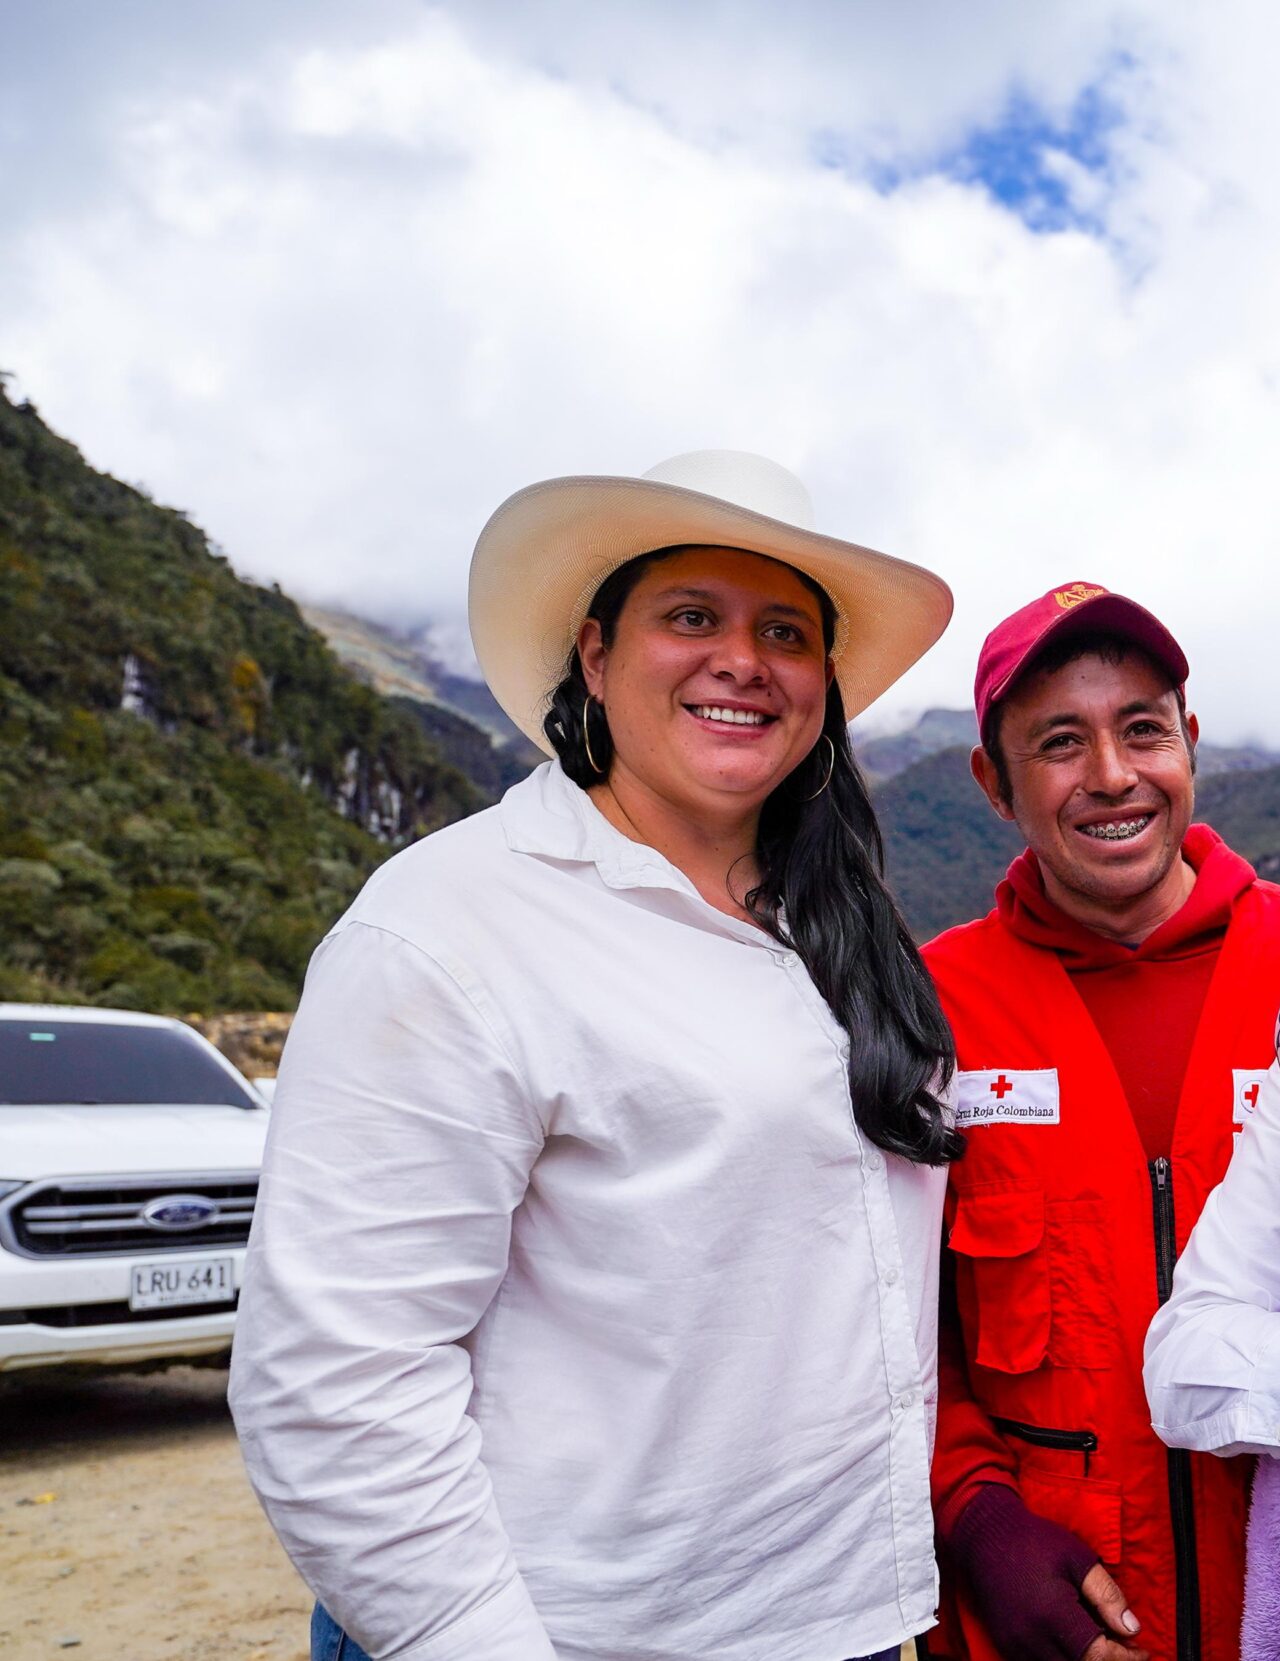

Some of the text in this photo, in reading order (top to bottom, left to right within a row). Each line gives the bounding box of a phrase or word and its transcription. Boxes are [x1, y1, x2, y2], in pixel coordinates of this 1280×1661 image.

[973, 1106, 994, 1118] Roja
[996, 1104, 1054, 1117] Colombiana
[136, 1265, 226, 1295] LRU 641
